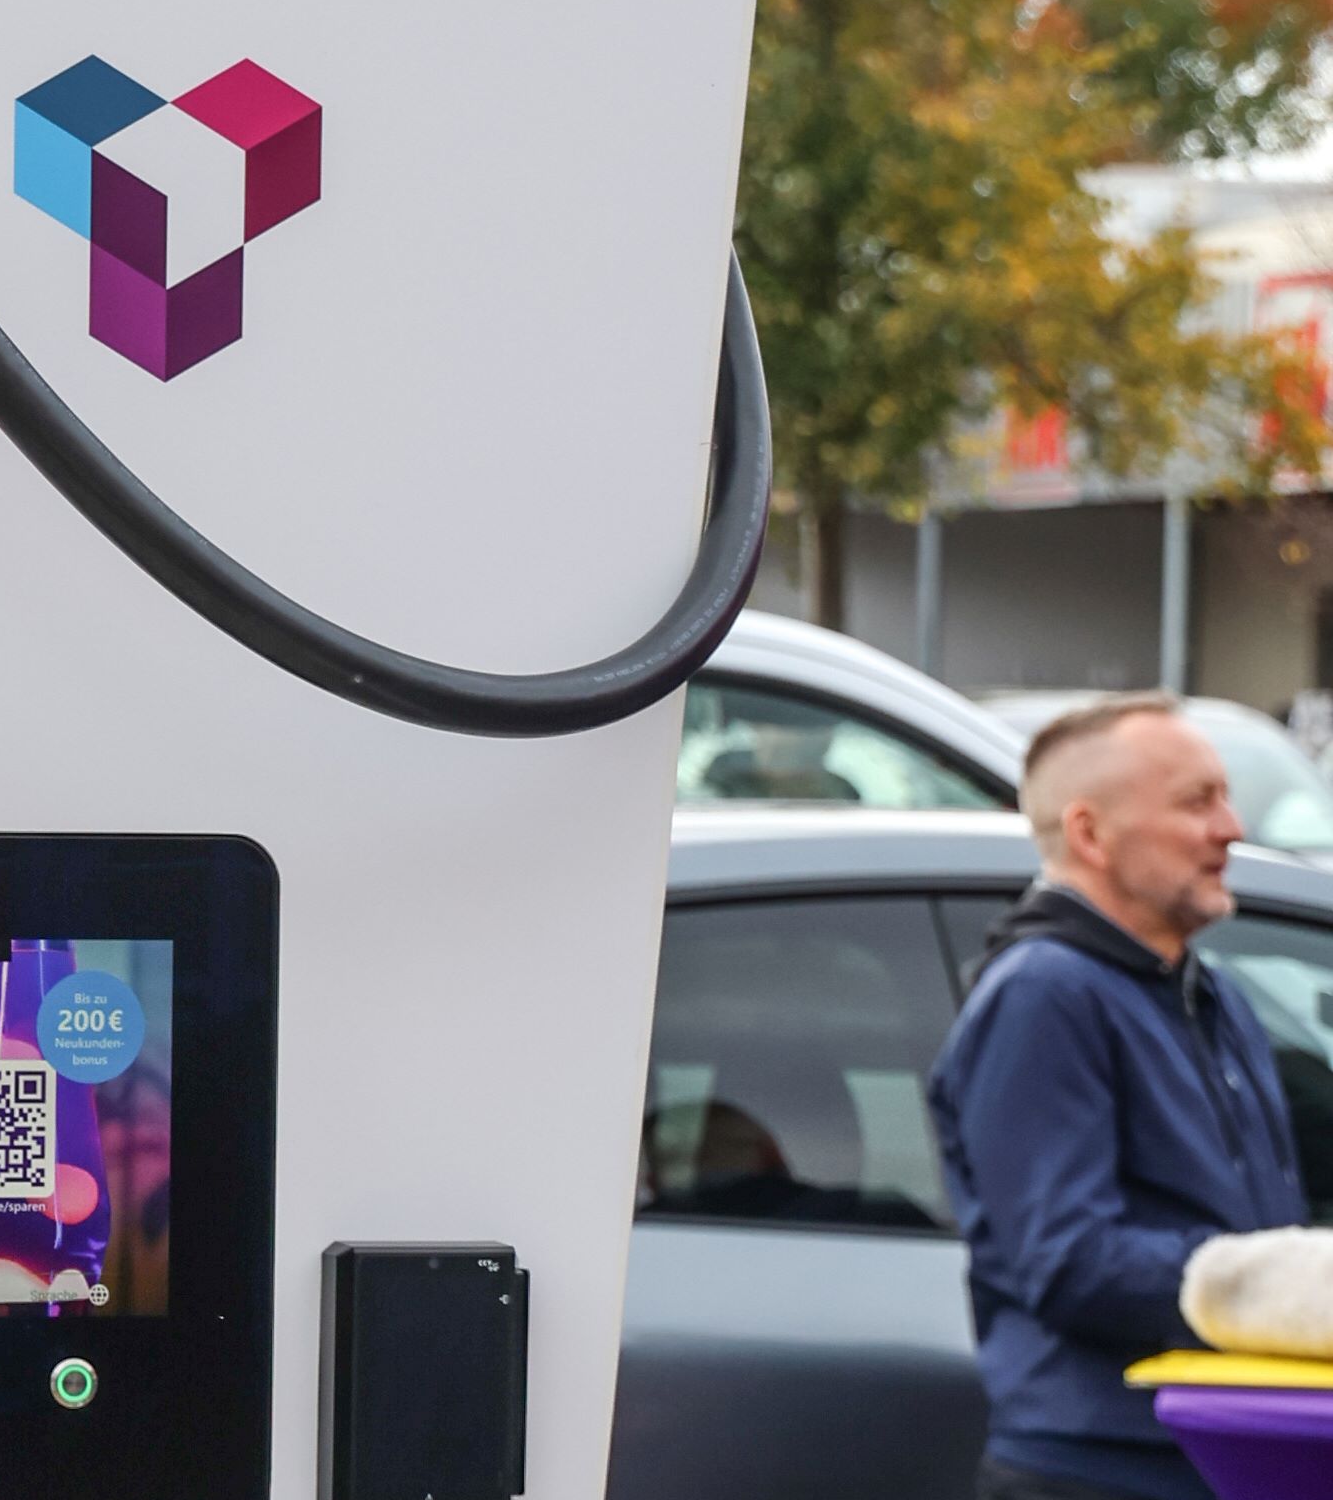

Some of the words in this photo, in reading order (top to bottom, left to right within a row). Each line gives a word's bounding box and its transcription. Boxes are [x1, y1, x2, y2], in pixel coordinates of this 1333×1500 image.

[74, 993, 91, 1004] Bis
[93, 996, 108, 1005] zu
[72, 1054, 108, 1066] bonus
